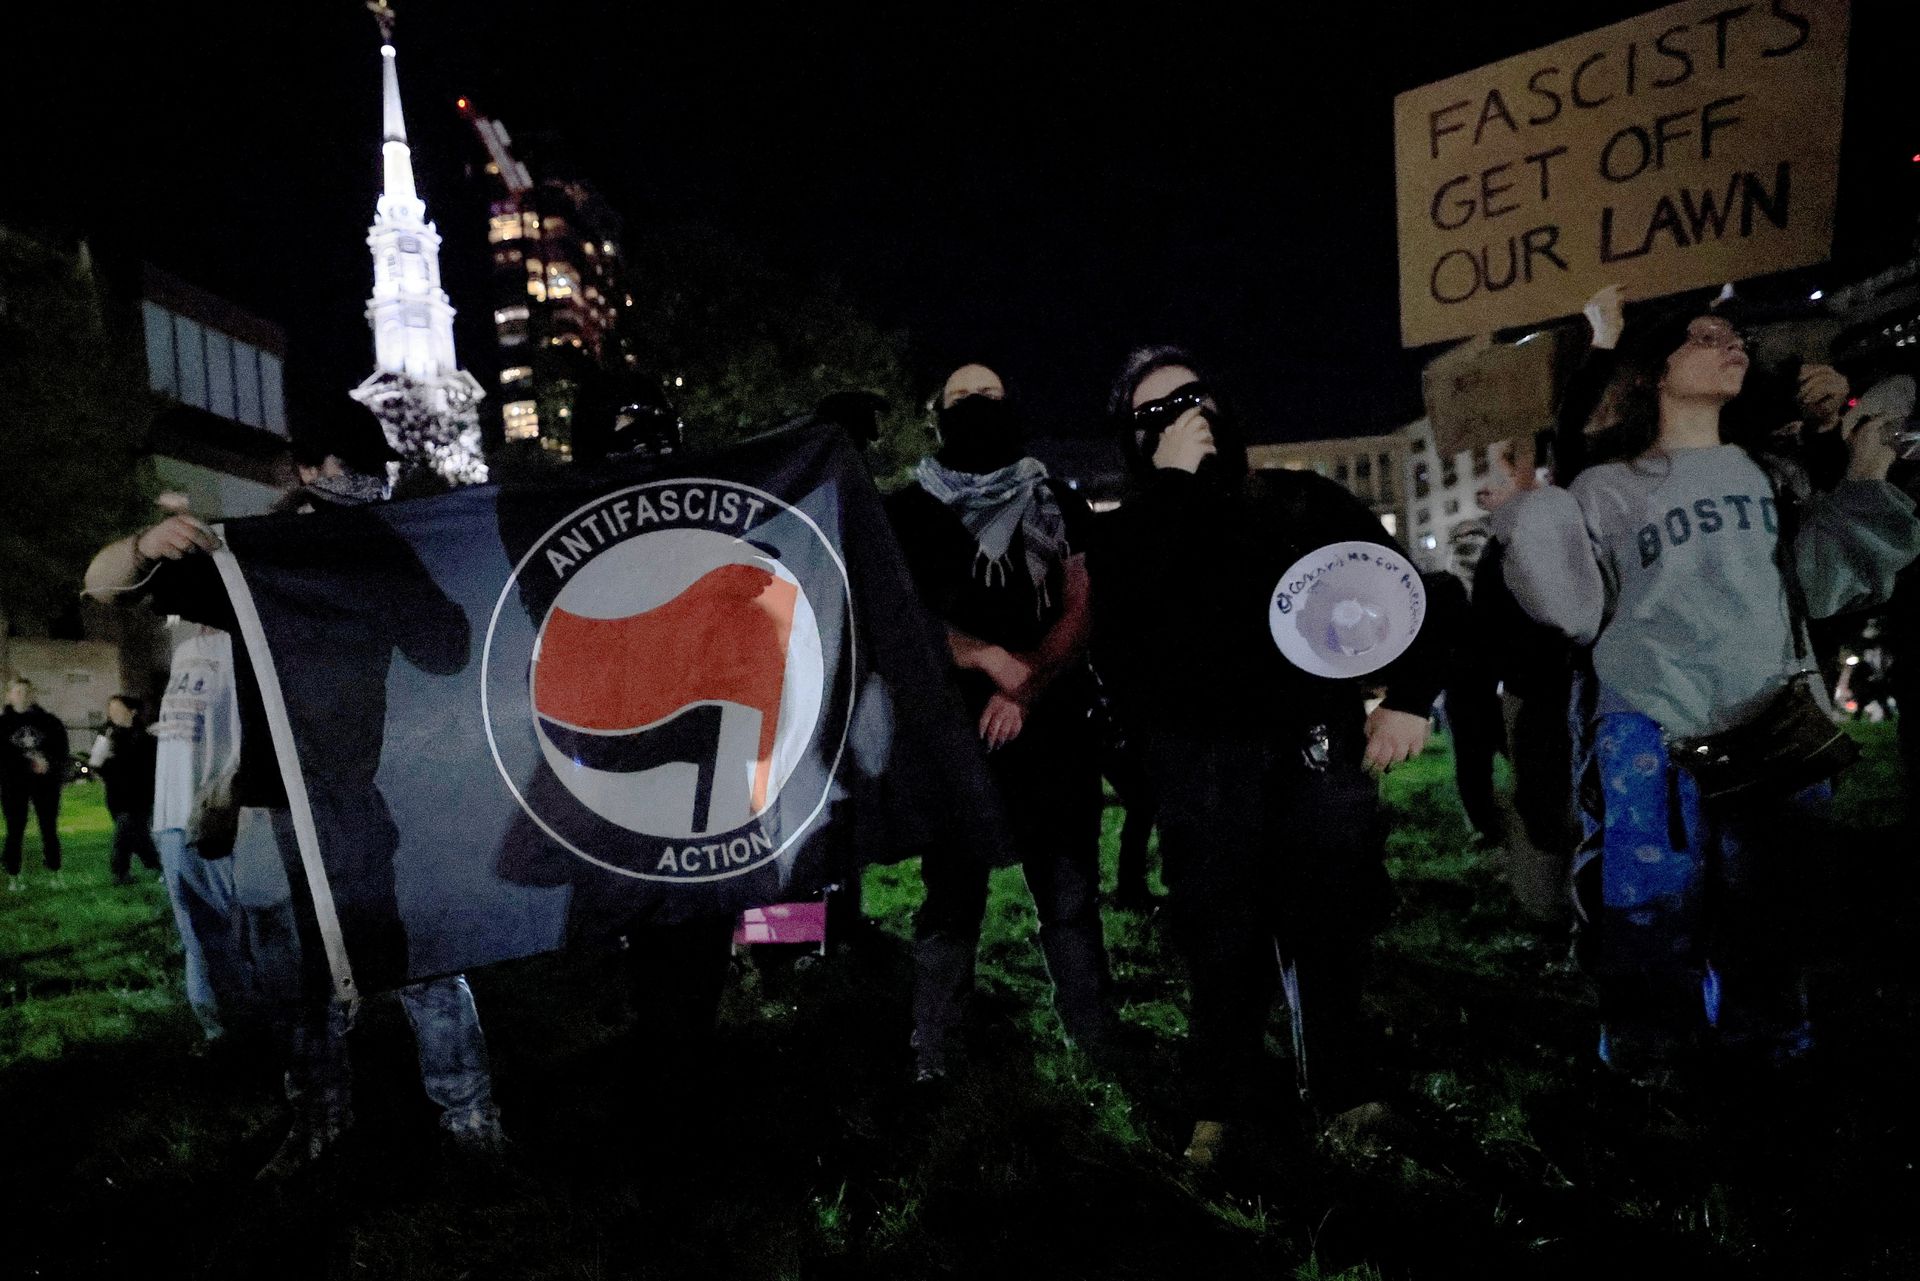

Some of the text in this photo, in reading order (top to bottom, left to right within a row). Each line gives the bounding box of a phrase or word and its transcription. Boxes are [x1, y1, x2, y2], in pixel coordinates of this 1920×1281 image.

[1428, 0, 1811, 159] FASCISTS
[1430, 94, 1748, 231] GET OFF
[1429, 160, 1793, 304] OUR LAWN
[544, 488, 766, 579] ANTIFASCIST
[657, 826, 774, 873] ACTION
